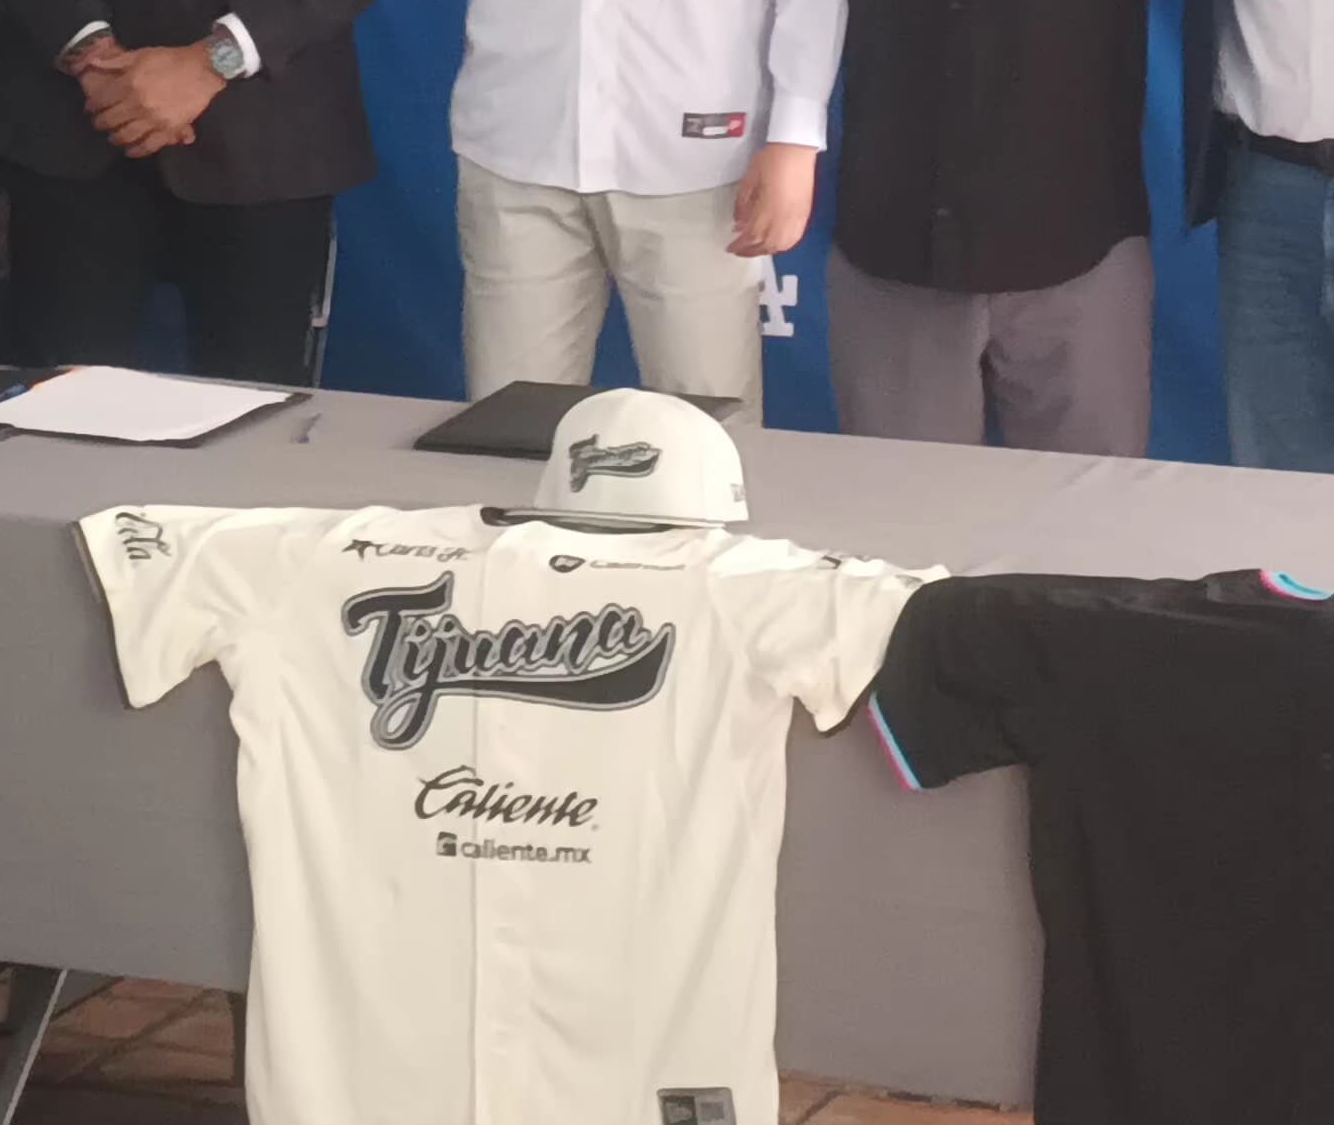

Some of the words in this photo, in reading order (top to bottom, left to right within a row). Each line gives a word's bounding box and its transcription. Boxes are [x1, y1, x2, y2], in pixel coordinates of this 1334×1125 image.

[341, 571, 676, 750] Tijuana
[414, 764, 598, 827] Caliente
[461, 838, 592, 864] caliente.mx
